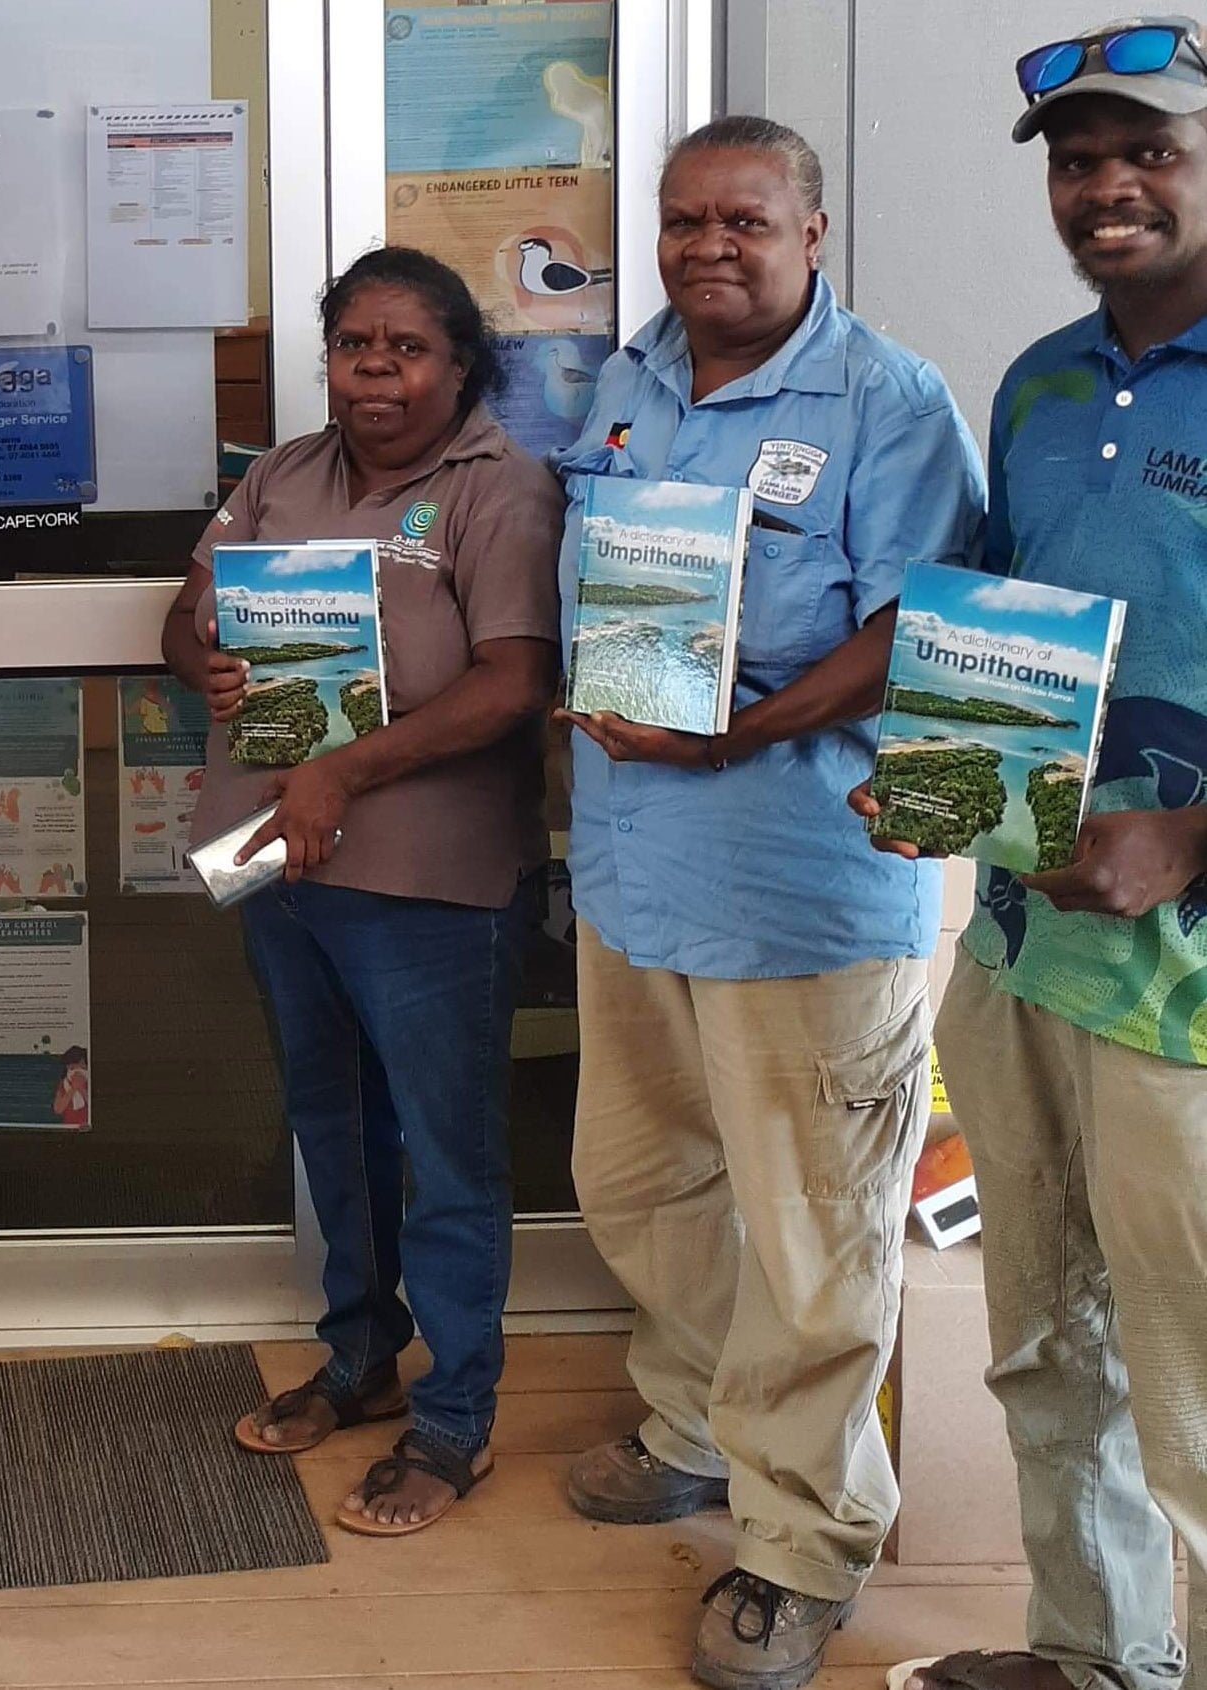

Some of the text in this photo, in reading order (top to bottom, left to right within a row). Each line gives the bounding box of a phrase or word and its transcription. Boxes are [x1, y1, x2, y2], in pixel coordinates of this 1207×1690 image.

[426, 175, 579, 193] ENDANGERED LITTLE TERN
[21, 413, 68, 425] Service
[756, 486, 800, 500] RANGER
[619, 529, 696, 546] A dictionary of
[597, 540, 715, 571] Umpithamu
[256, 596, 337, 607] A dictionary of
[235, 607, 360, 627] Umpithamu
[947, 630, 1053, 661] A dictionary of
[916, 639, 1078, 693] Umpithamu
